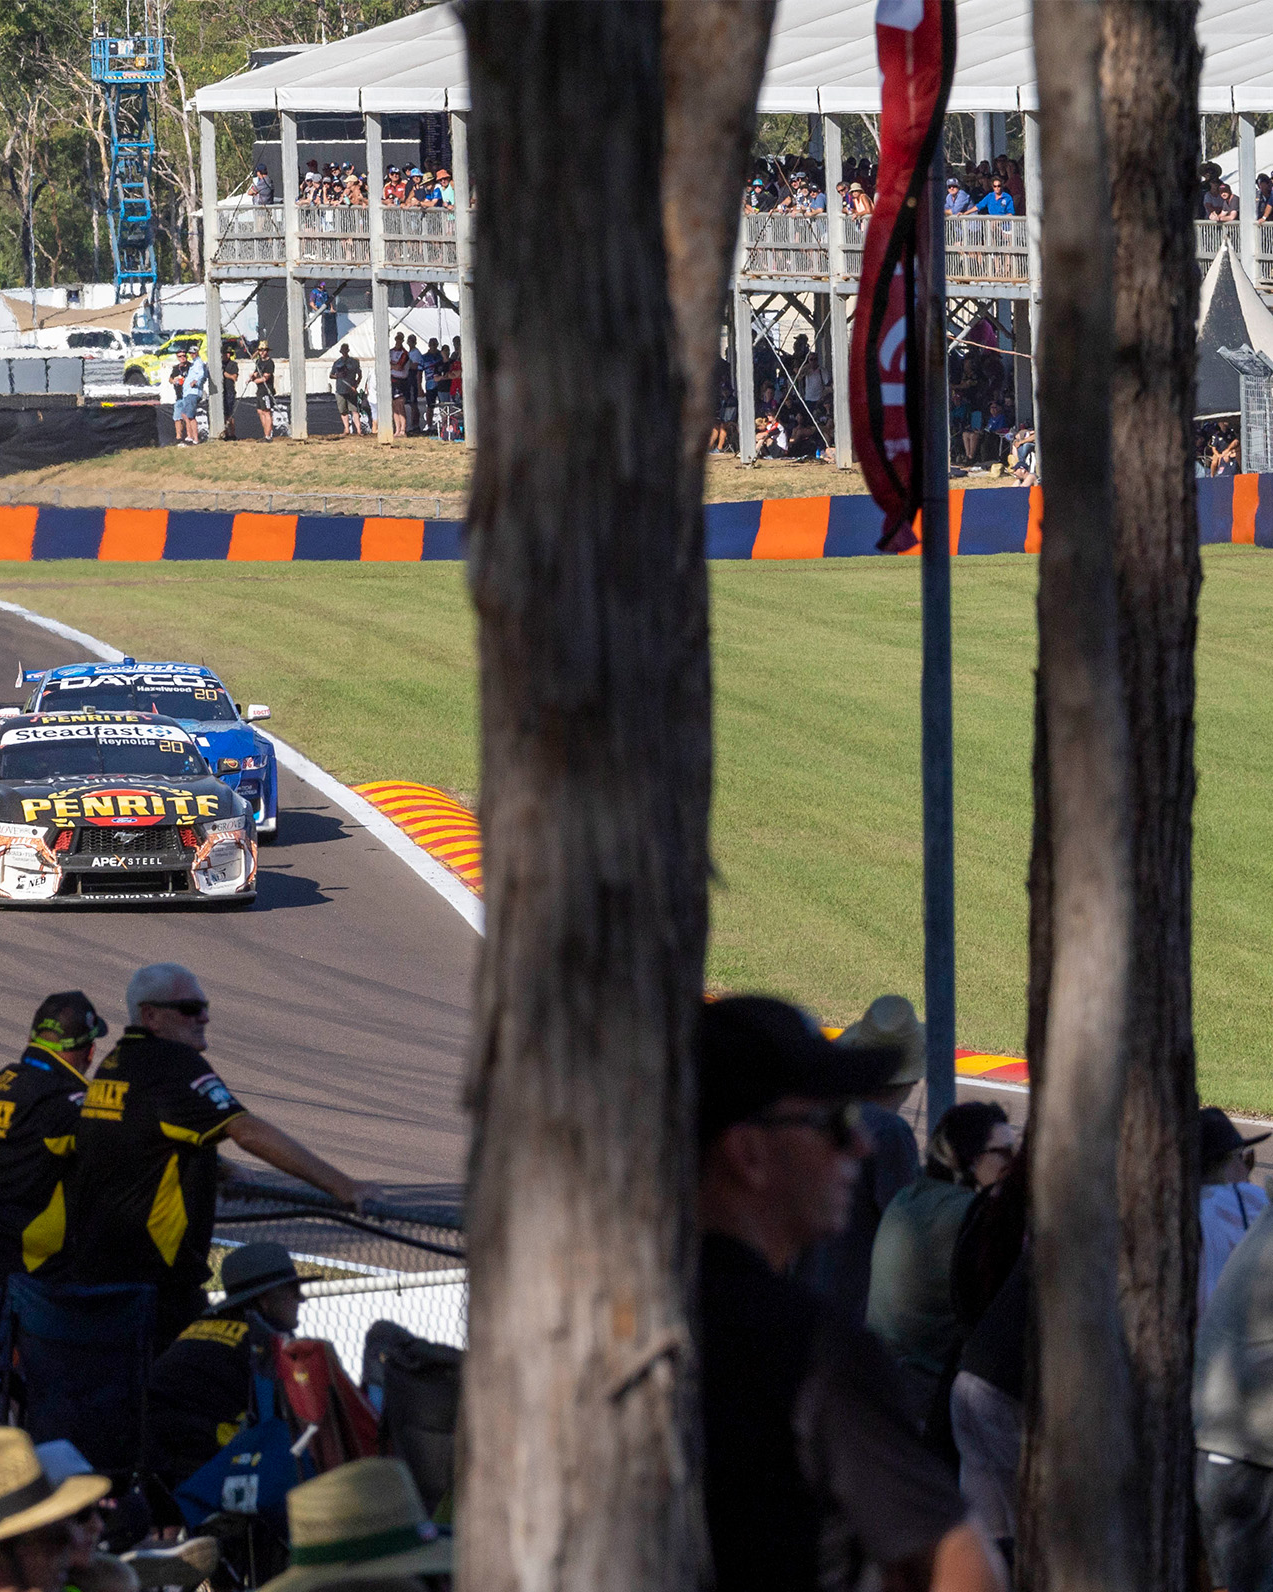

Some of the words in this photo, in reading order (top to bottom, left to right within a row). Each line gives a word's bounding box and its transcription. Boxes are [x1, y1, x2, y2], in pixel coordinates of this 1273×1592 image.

[136, 685, 192, 693] Hazelwood
[194, 688, 218, 701] 20
[41, 714, 139, 724] PENRITE
[15, 725, 142, 741] Steadfast
[99, 737, 156, 747] Reynolds
[159, 740, 185, 754] 20
[21, 795, 219, 823] PENRITE
[218, 819, 242, 832] GROVE
[92, 853, 128, 870] APEX
[128, 857, 162, 866] STEEL
